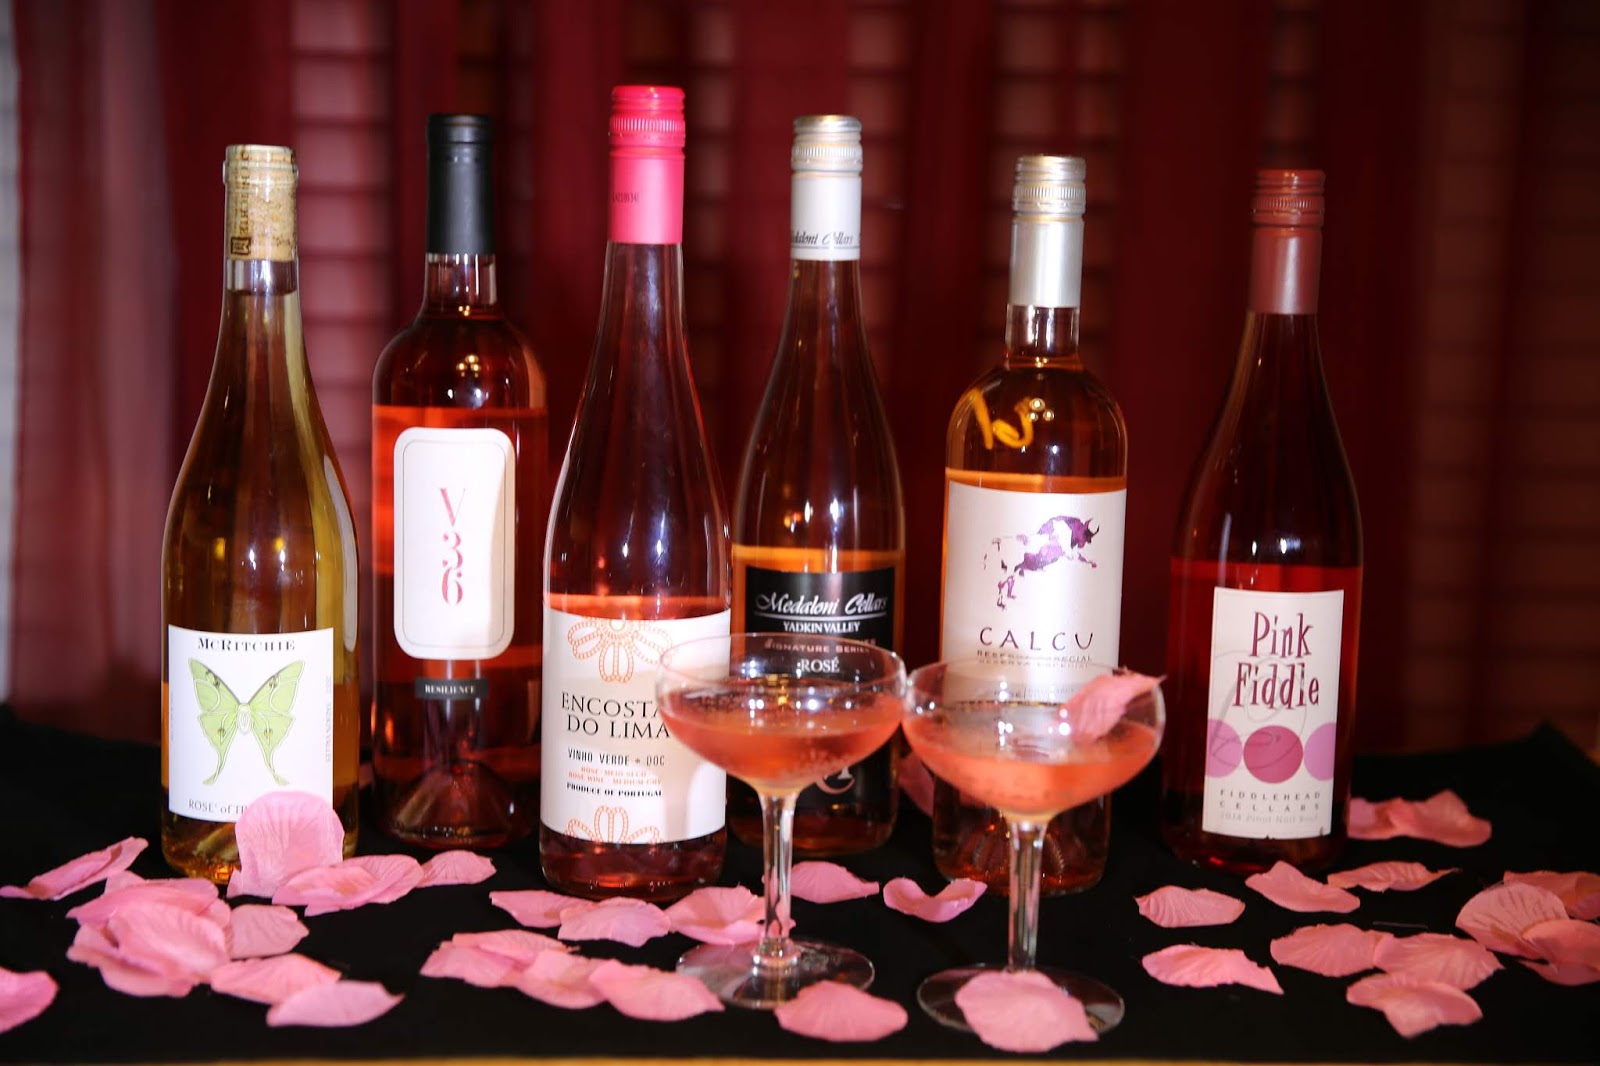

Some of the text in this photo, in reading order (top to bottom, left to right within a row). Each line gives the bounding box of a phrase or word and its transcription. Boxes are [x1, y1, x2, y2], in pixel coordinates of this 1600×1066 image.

[756, 592, 888, 615] Medaloni Cellars
[783, 621, 860, 633] YADKIN VALLEY
[1250, 611, 1313, 658] Pink
[979, 626, 1094, 651] CALCU
[800, 656, 840, 674] ROSÉ
[424, 684, 475, 694] RESILIENCE
[1233, 661, 1320, 710] Fiddle
[567, 714, 670, 739] DO LIMA
[567, 746, 665, 767] VINHO VERDE DOC
[567, 781, 600, 796] PRODUCT
[618, 789, 663, 798] PORTUGAL
[1220, 789, 1320, 801] FIDDLEHEAD
[1219, 800, 1320, 813] CELLARS
